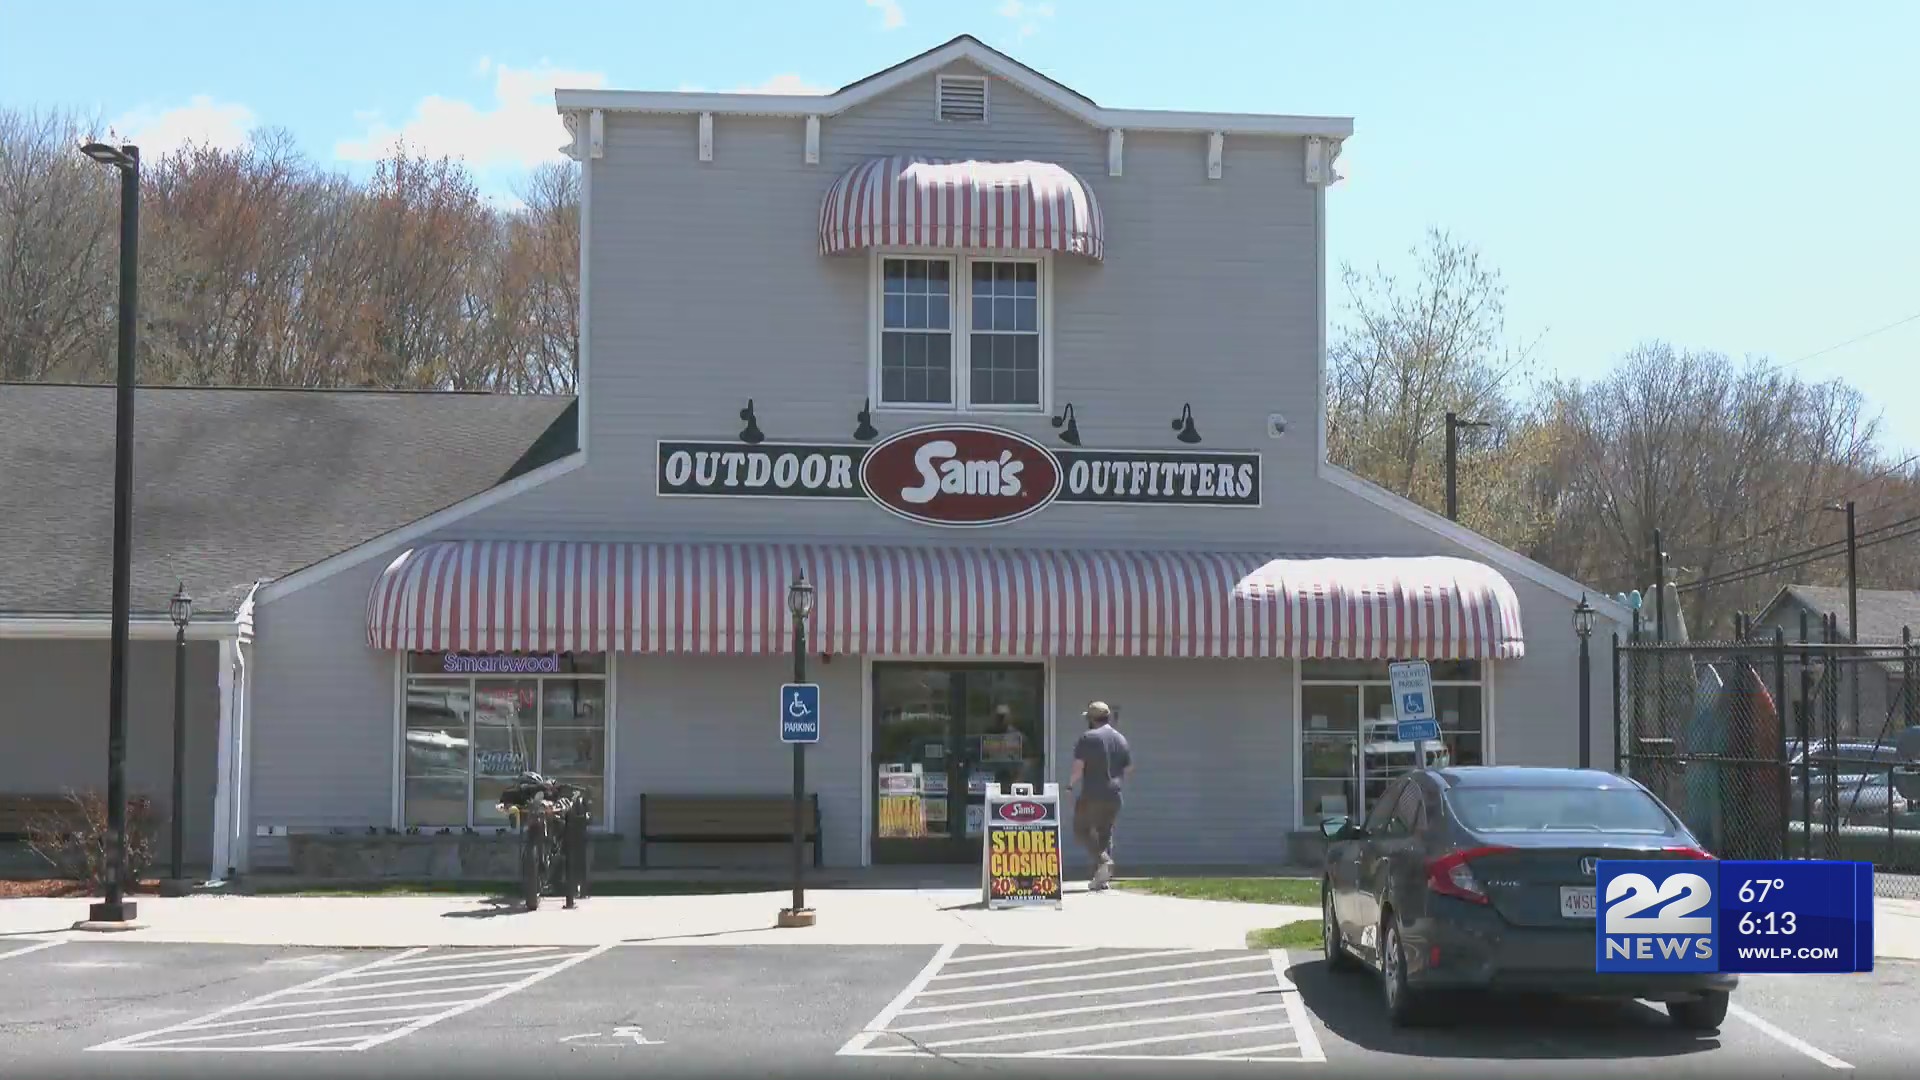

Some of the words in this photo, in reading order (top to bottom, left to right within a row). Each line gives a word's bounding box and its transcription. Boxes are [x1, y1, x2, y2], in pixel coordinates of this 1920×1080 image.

[664, 451, 853, 489] OUTDOOR
[901, 440, 1025, 504] Sam's
[1069, 462, 1253, 499] OUTFITTERS
[444, 652, 559, 672] Smartwool
[784, 721, 816, 733] PARKING
[1011, 803, 1035, 817] Sam's
[992, 830, 1056, 854] STORE
[991, 853, 1058, 877] CLOSING
